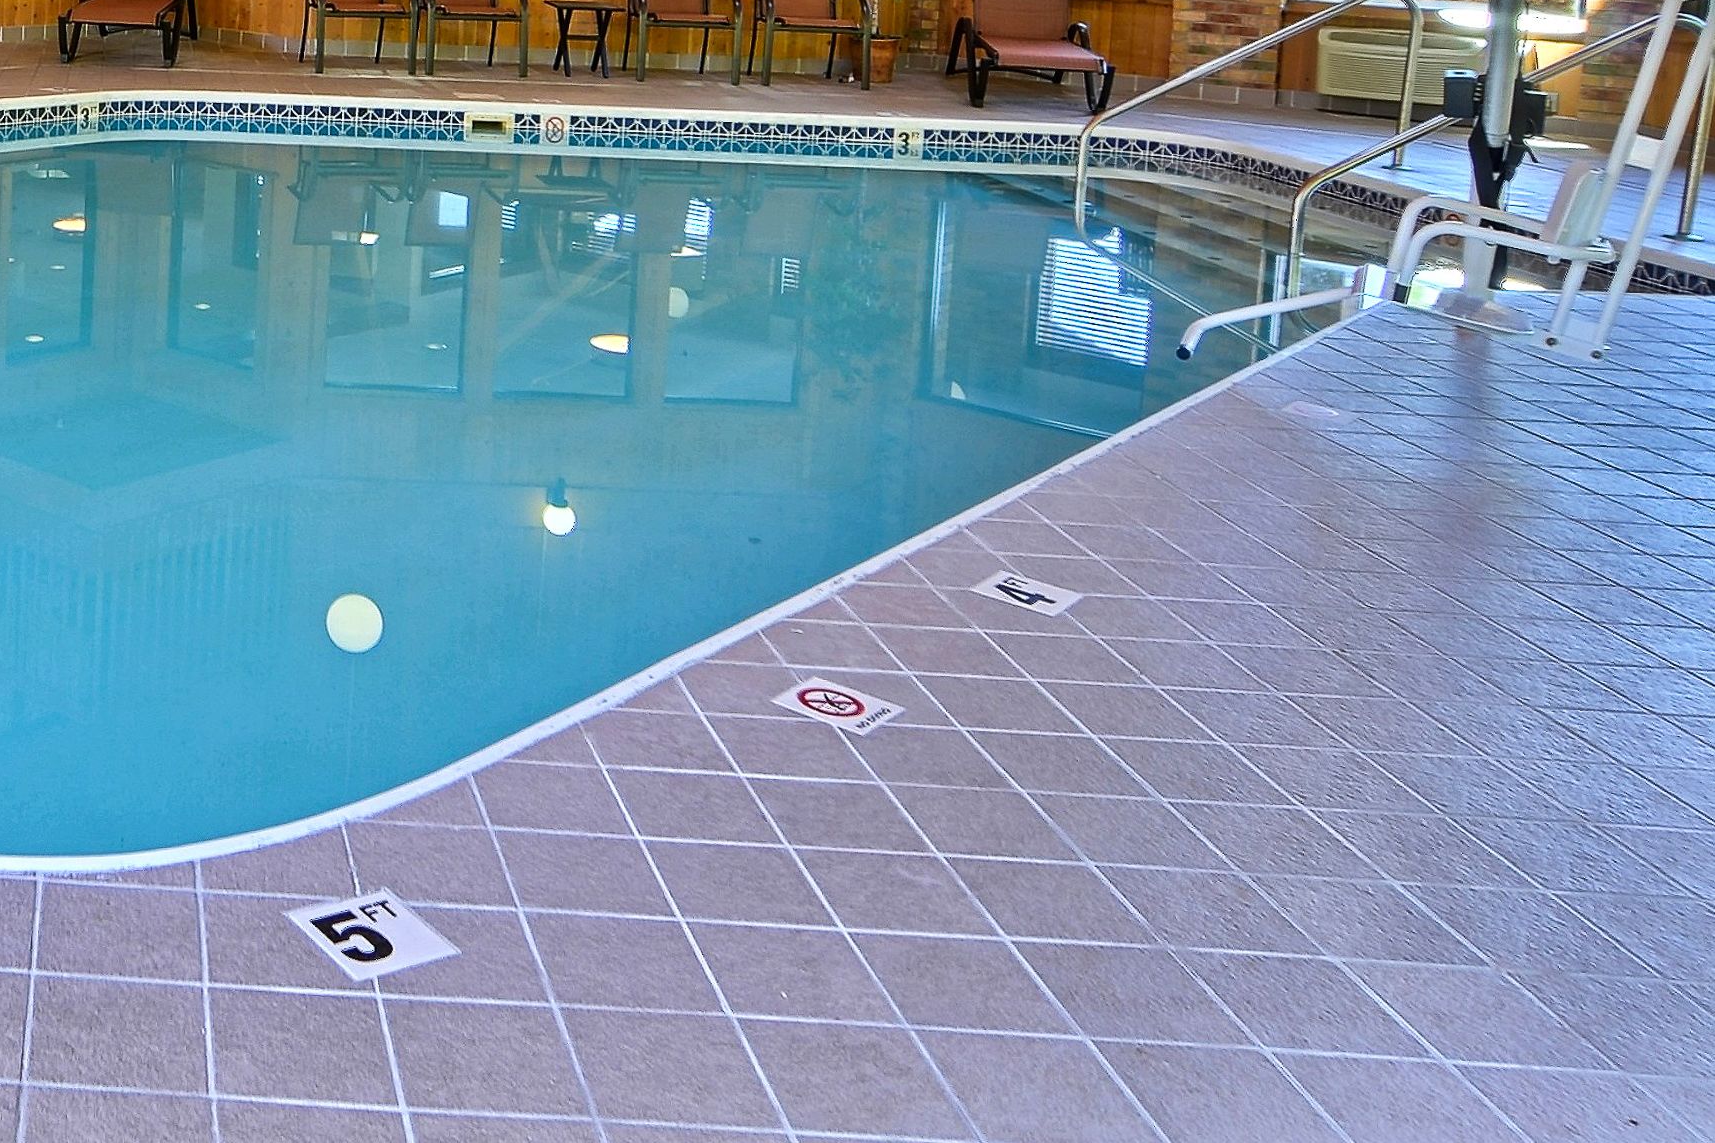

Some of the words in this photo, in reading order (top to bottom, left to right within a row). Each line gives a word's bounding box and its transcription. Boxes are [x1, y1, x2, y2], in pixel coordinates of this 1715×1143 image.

[993, 584, 1057, 606] 4
[309, 910, 394, 962] 5
[358, 900, 398, 923] FT
